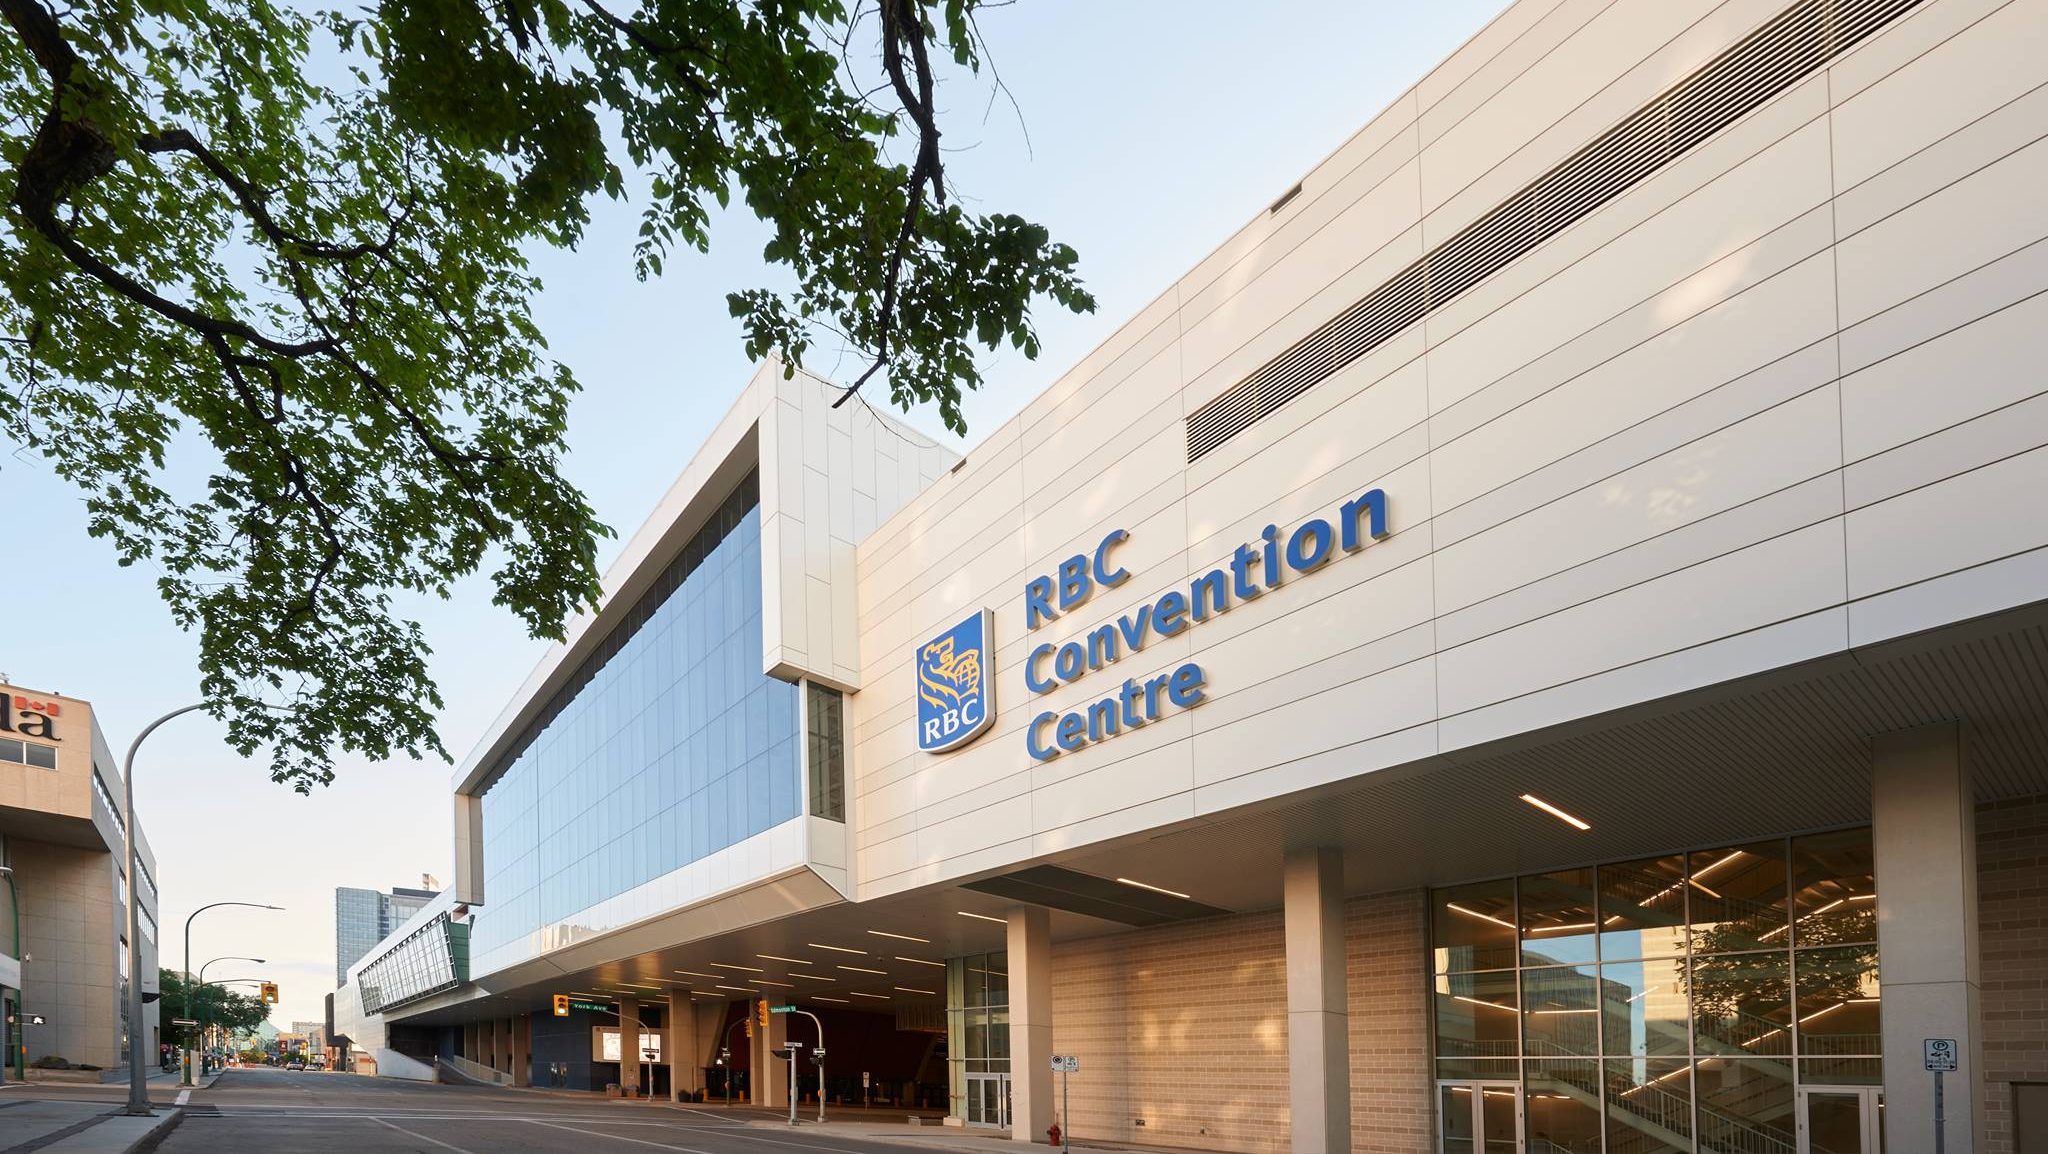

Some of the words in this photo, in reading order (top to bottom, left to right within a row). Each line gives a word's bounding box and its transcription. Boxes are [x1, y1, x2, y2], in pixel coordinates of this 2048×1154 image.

[1025, 528, 1131, 631] RBC
[1025, 488, 1391, 695] Convention
[924, 698, 979, 744] RBC
[1026, 662, 1207, 762] Centre
